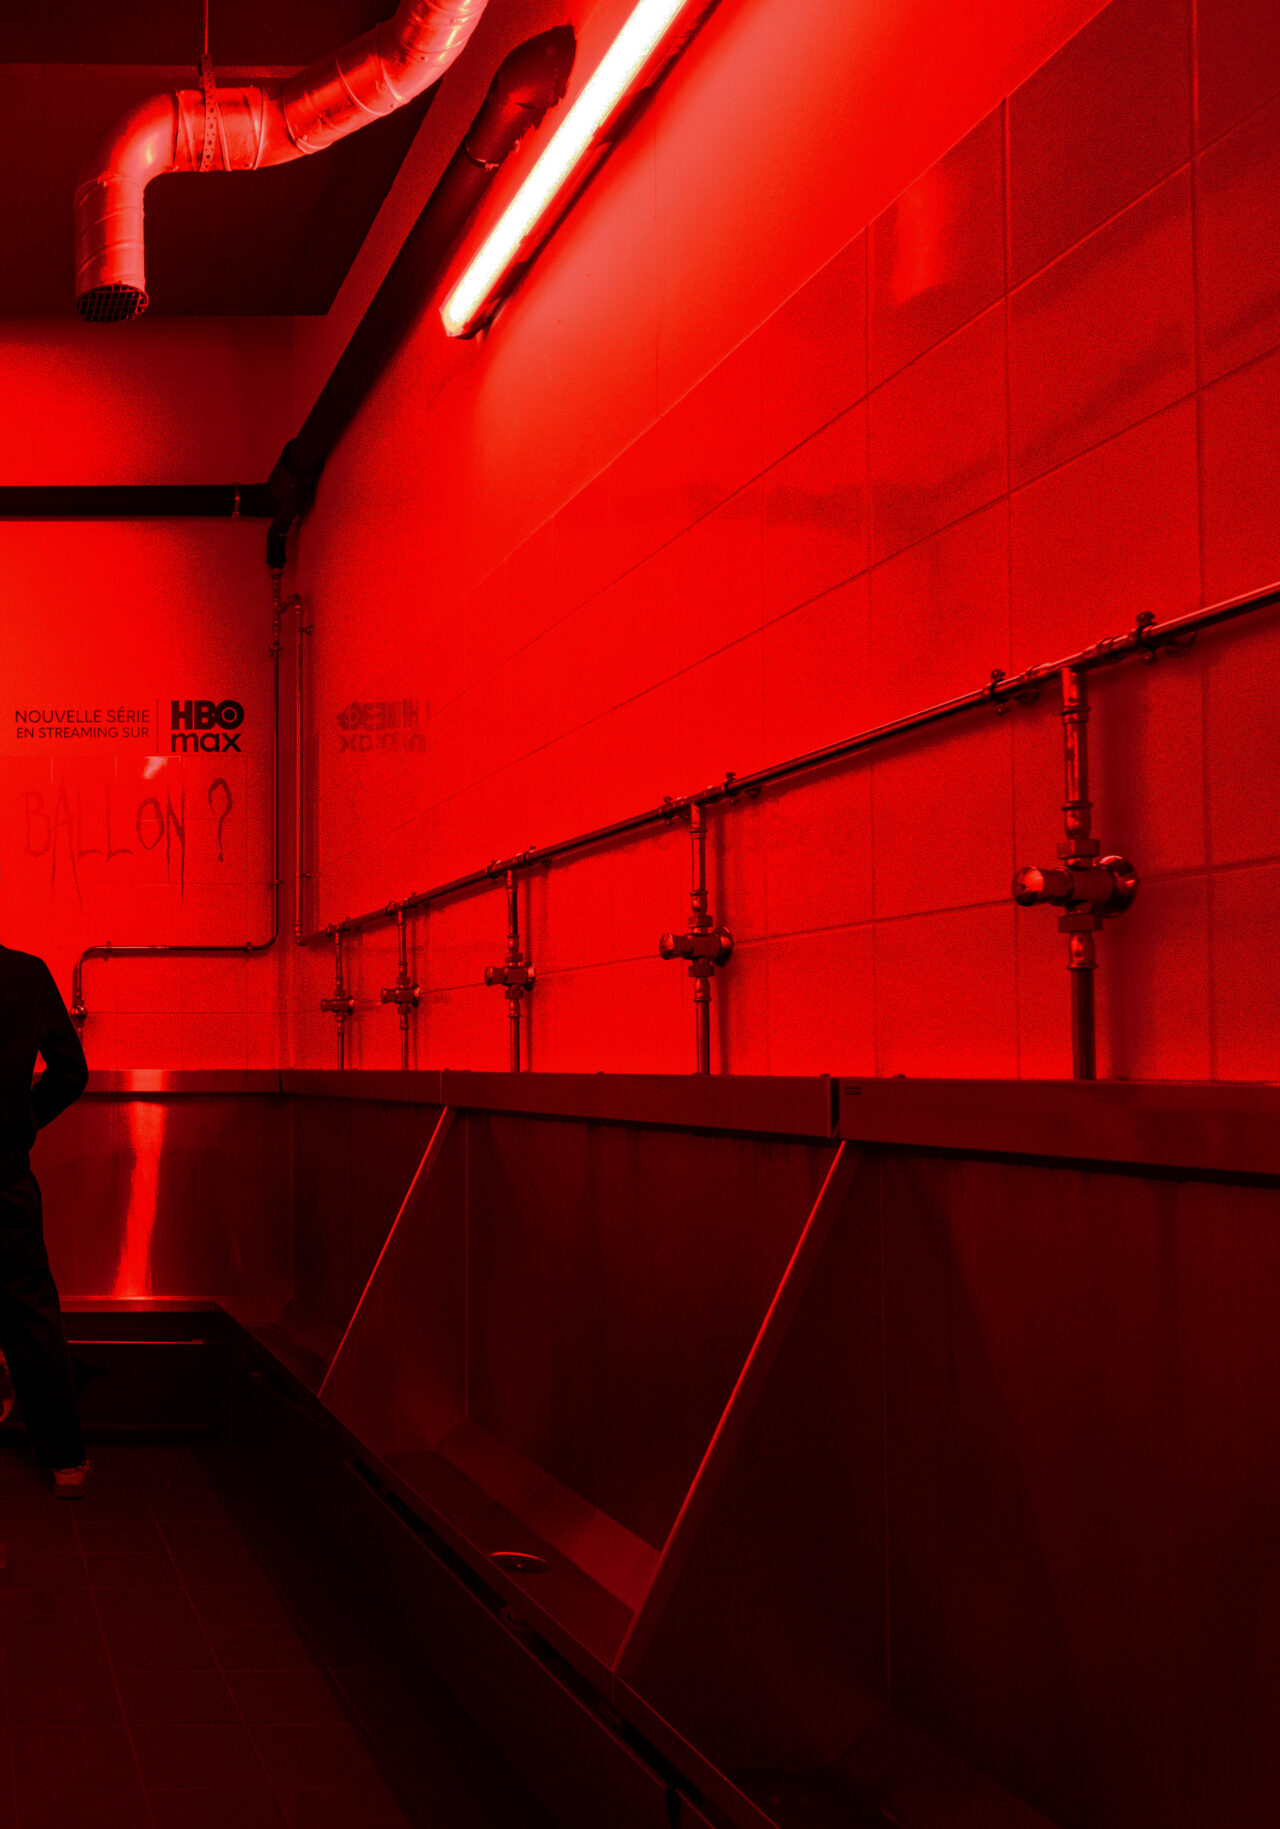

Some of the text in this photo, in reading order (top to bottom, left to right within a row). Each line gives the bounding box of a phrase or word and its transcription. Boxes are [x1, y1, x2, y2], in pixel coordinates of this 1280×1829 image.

[15, 706, 150, 724] NOUVELLE SÉRIE
[171, 700, 245, 731] HBO
[16, 727, 149, 739] EN STREAMING SUR
[171, 733, 241, 753] max
[24, 776, 185, 908] BALLON
[208, 777, 232, 862] ?
